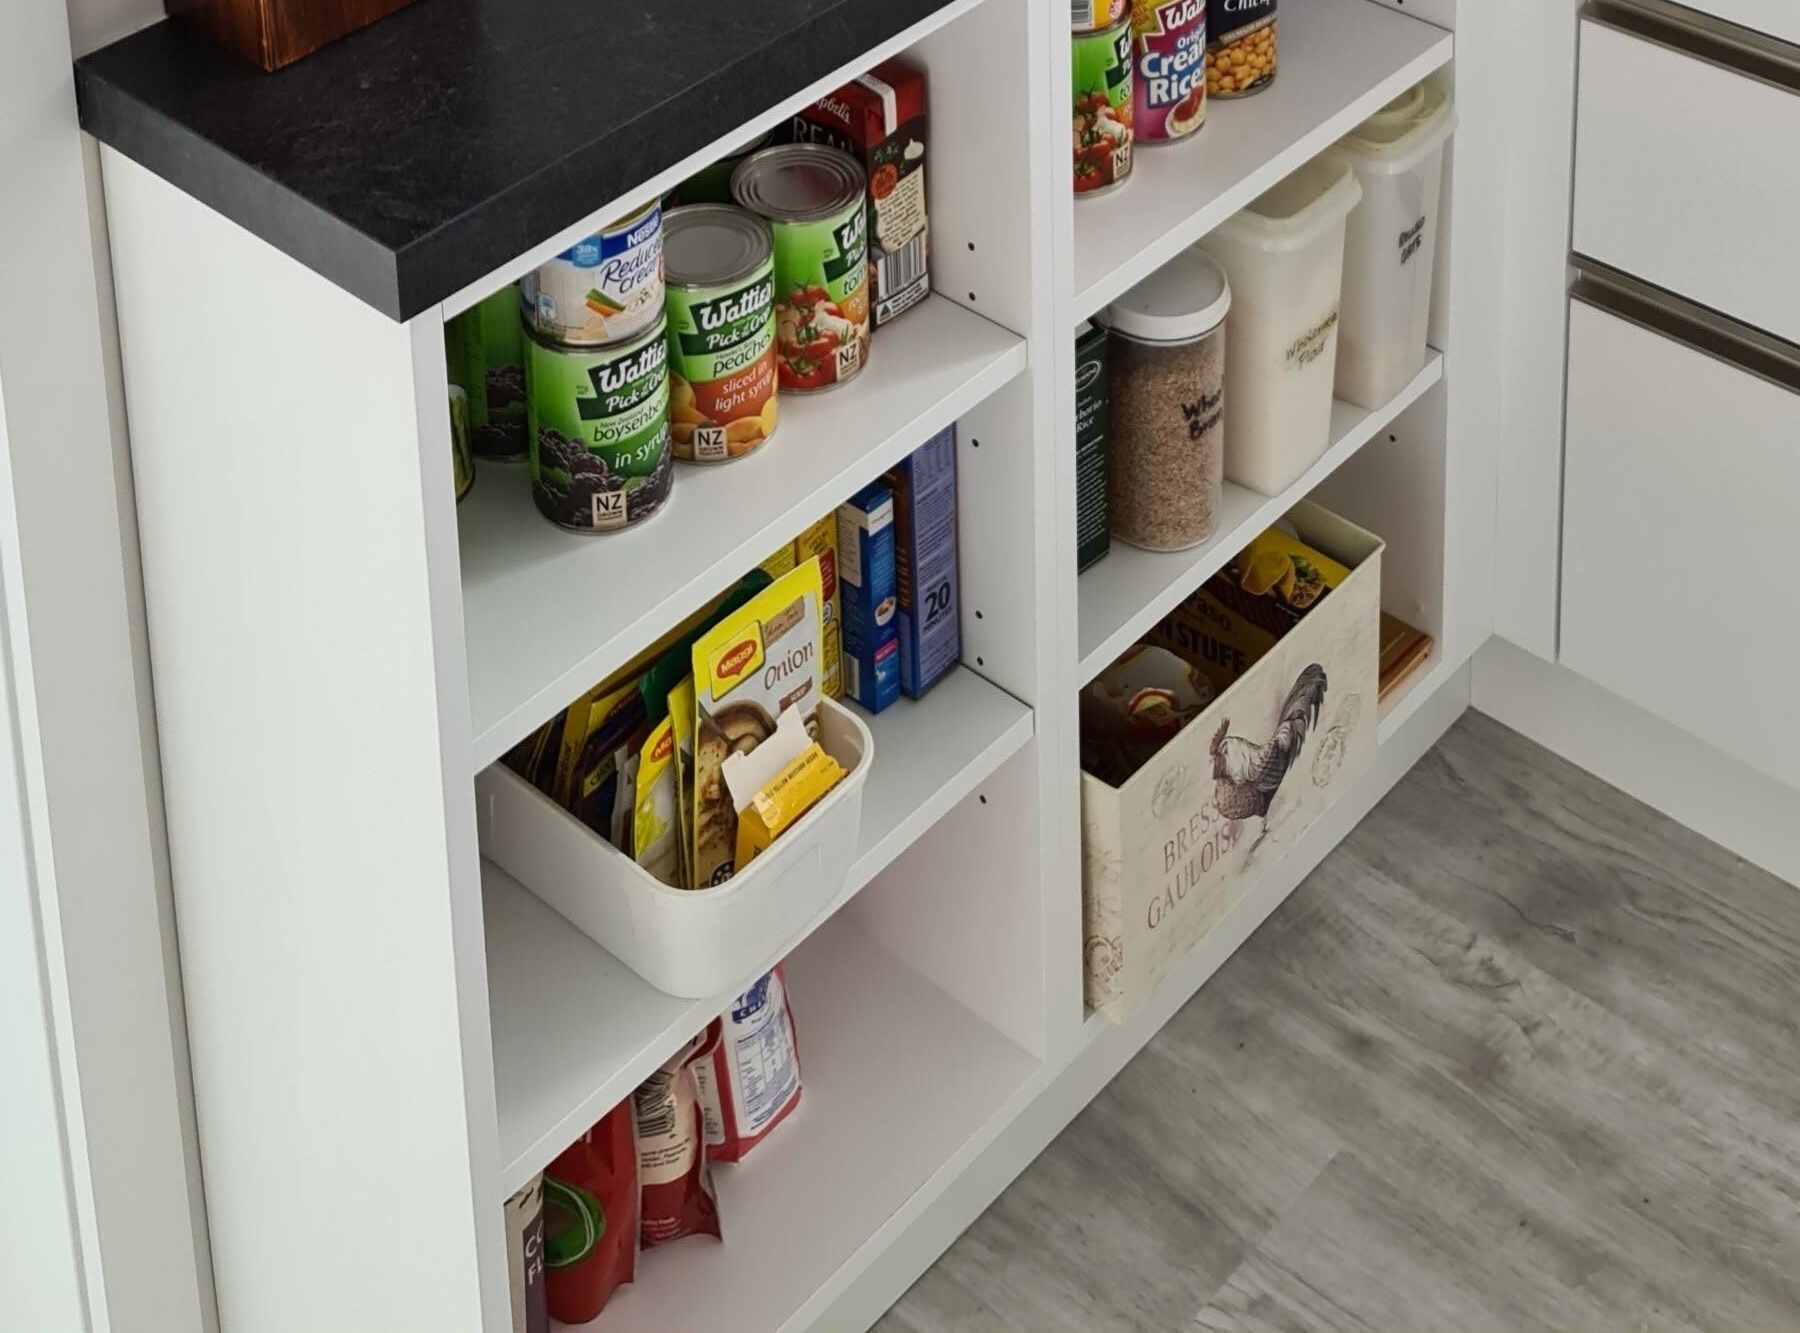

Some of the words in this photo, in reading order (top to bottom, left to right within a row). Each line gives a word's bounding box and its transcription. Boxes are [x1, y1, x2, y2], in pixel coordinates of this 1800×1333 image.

[1149, 66, 1204, 105] Rice
[706, 331, 740, 350] Pick
[839, 342, 858, 366] NZ
[722, 371, 757, 395] sliced
[757, 360, 768, 376] in
[604, 391, 640, 414] Pick
[715, 394, 745, 413] light
[697, 430, 724, 446] NZ
[614, 452, 632, 469] in
[596, 493, 623, 512] NZ
[924, 581, 951, 624] 20
[720, 642, 753, 674] Maggi
[764, 640, 814, 691] Onion
